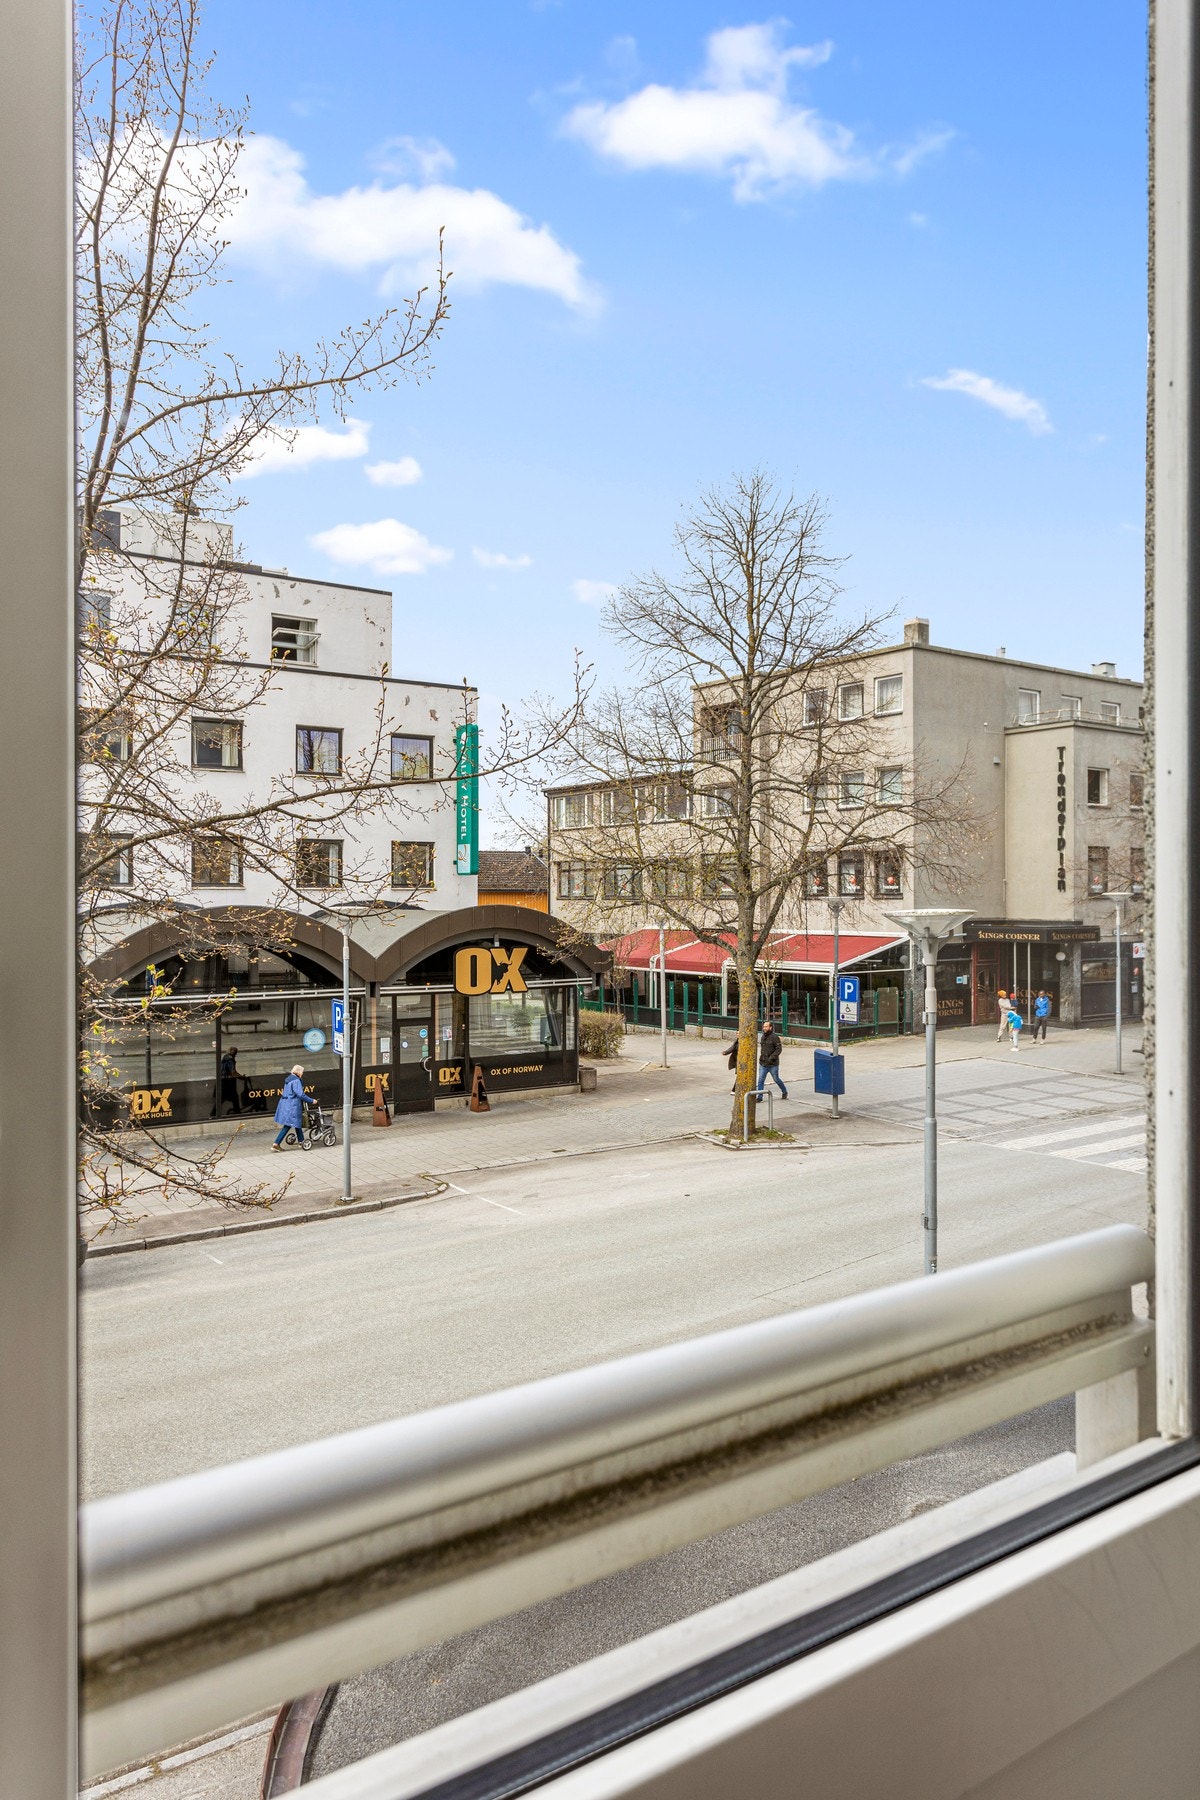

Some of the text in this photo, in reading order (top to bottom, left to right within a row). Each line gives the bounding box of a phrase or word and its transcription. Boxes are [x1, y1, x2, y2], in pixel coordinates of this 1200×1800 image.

[461, 795, 469, 840] HOTEL
[977, 931, 1004, 939] KINGS
[455, 947, 528, 995] OX
[844, 981, 854, 999] P
[335, 1006, 342, 1028] P
[937, 1008, 964, 1016] ORNER
[439, 1067, 461, 1082] OX
[491, 1065, 543, 1076] OX OF NORWAY
[248, 1090, 262, 1098] OX
[263, 1088, 275, 1097] OF
[132, 1089, 172, 1114] OX
